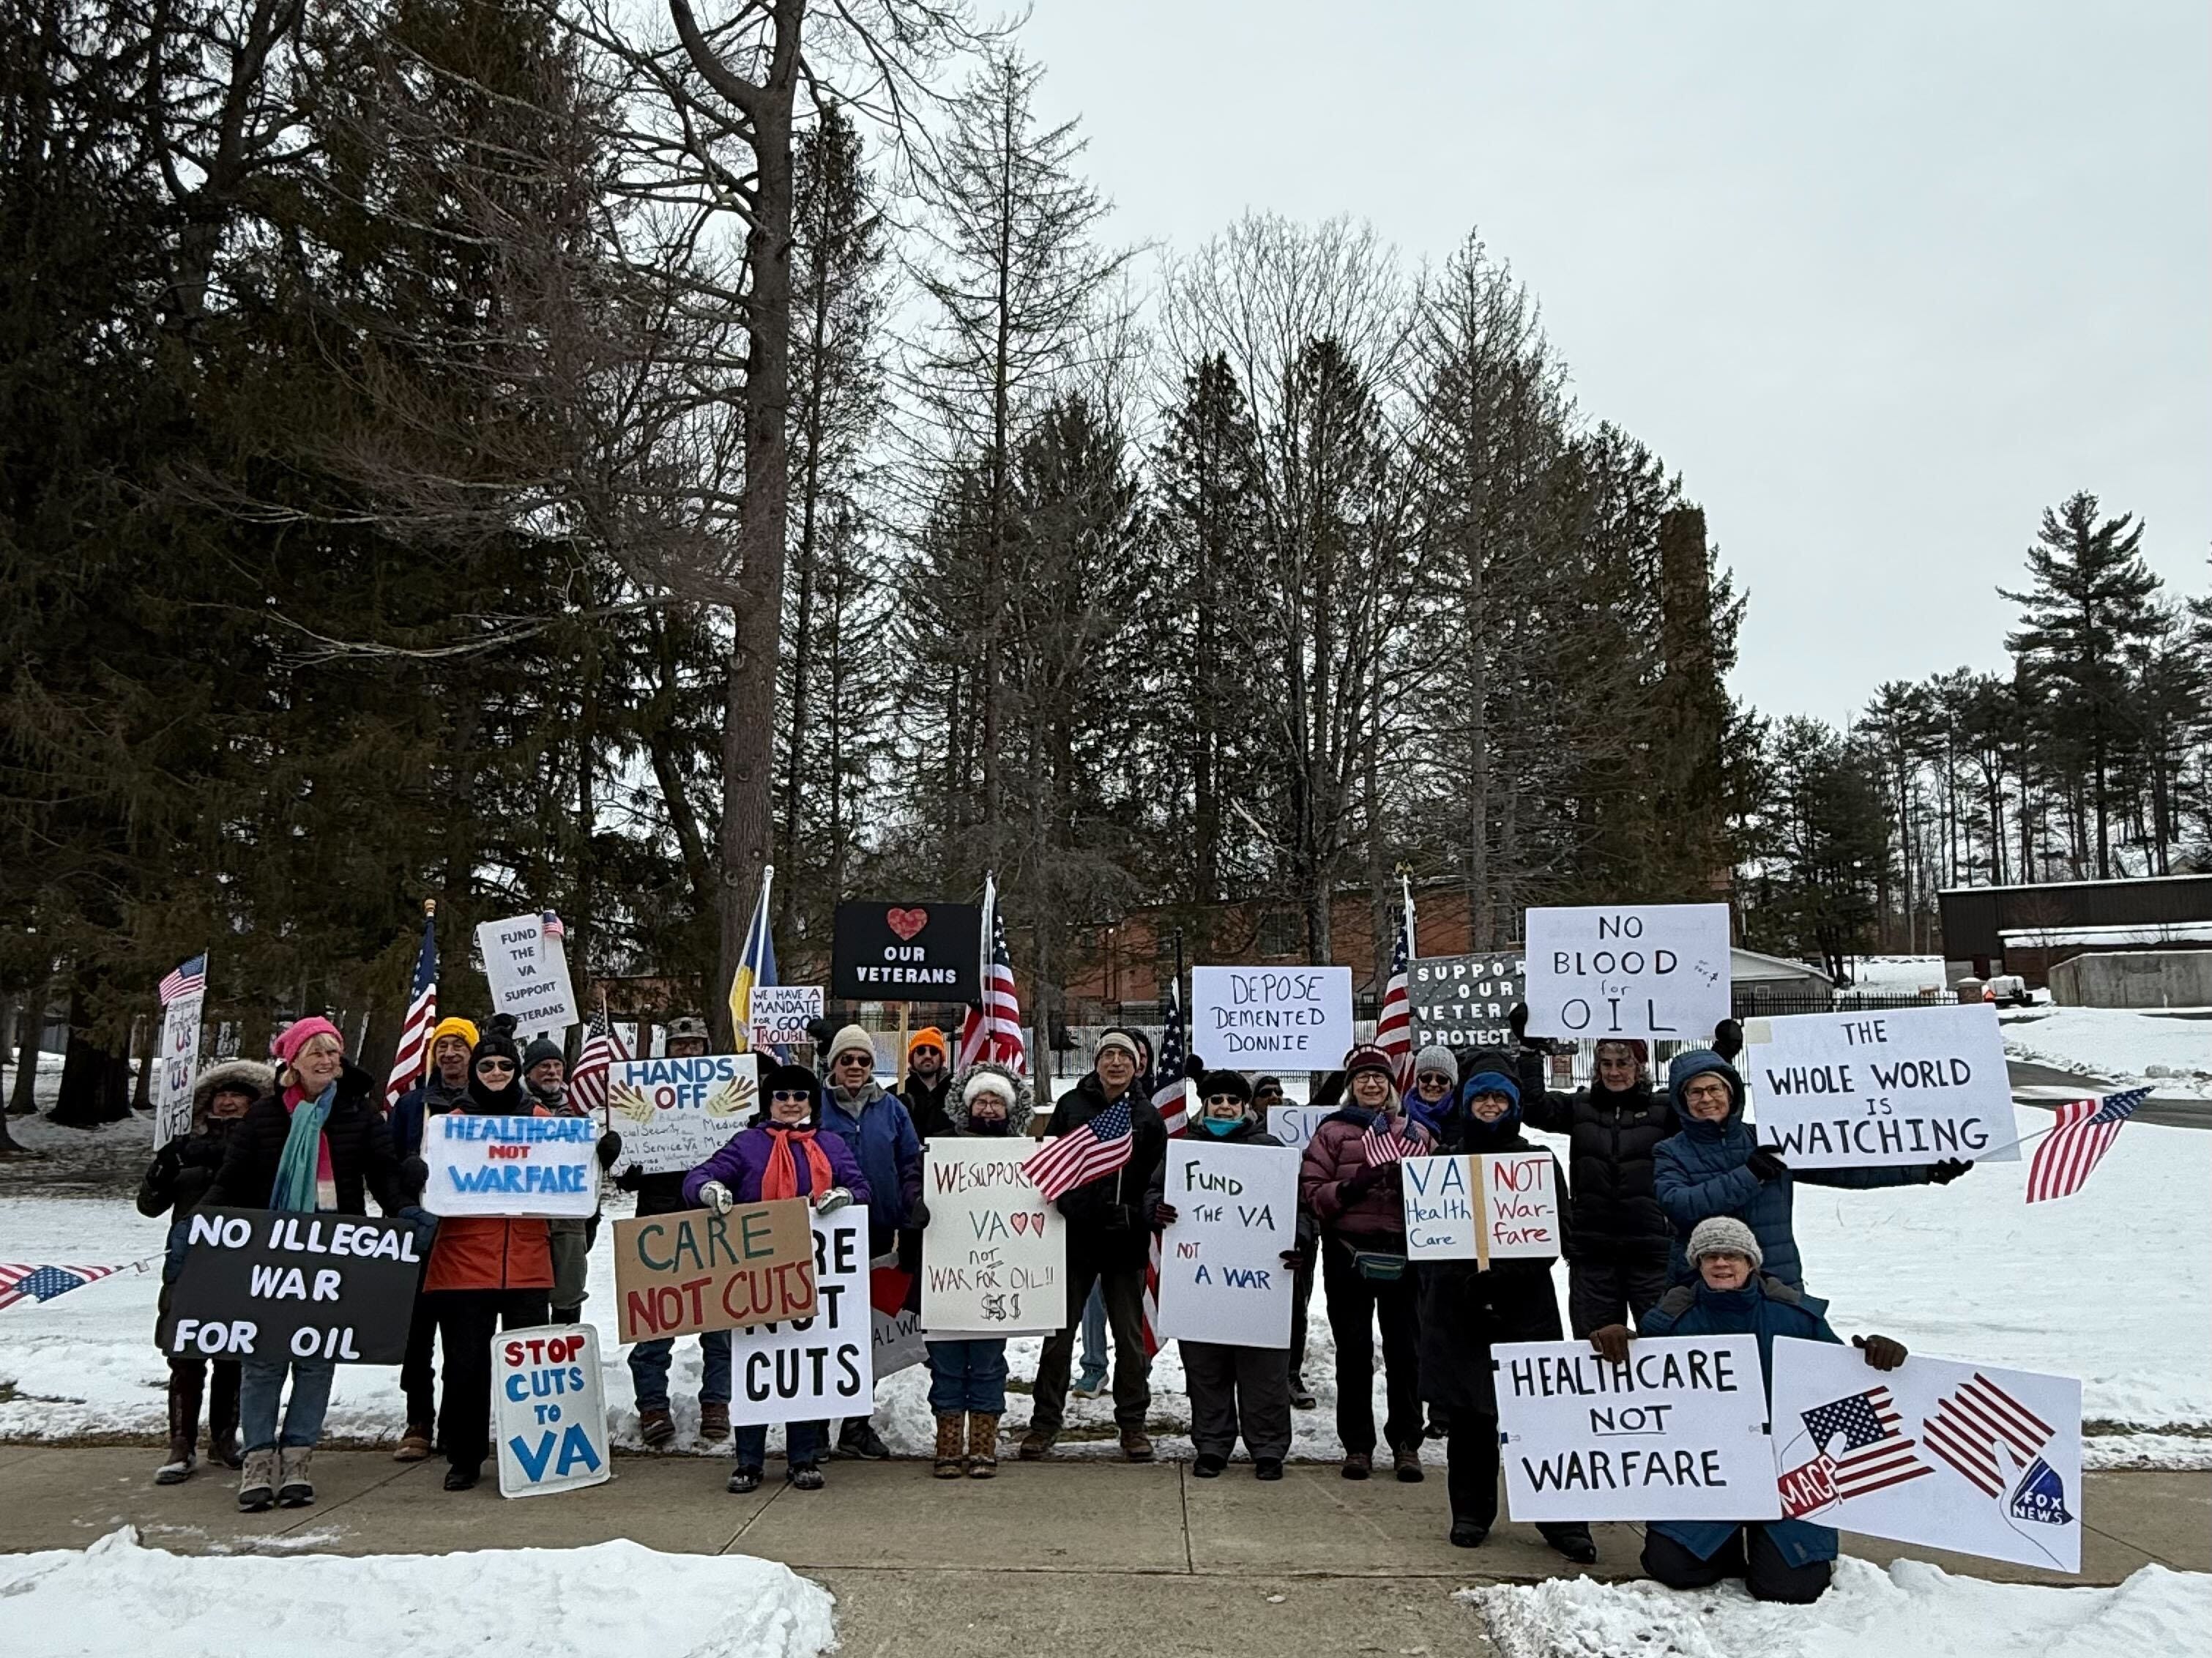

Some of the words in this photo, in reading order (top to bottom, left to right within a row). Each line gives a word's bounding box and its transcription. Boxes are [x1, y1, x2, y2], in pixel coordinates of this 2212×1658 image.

[501, 929, 537, 945] FUND
[1599, 915, 1643, 940] NO
[510, 946, 535, 961] THE
[884, 946, 926, 962] OUR
[1554, 949, 1678, 975] BLOOD
[517, 964, 537, 977] VA
[856, 966, 957, 984] VETERANS
[1417, 961, 1525, 982] SUPPOR
[504, 981, 557, 1002] SUPPORT
[753, 989, 768, 1000] WE
[776, 989, 803, 1000] HAVE
[808, 988, 820, 999] A
[1230, 973, 1325, 1005] DEPOSE
[1458, 982, 1513, 999] OUR
[1601, 978, 1633, 996] for
[515, 1003, 565, 1023] ETERANS
[752, 1000, 821, 1014] MANDATE
[1210, 1006, 1325, 1030] DEMENTED
[1561, 997, 1677, 1032] OIL
[176, 1025, 192, 1052] US
[1224, 1033, 1309, 1053] DONNIE
[1419, 1029, 1512, 1046] PROTECT
[1840, 1019, 1888, 1046] THE
[171, 1066, 188, 1091] US
[626, 1057, 735, 1087] HANDS
[1766, 1064, 1855, 1096] WHOLE
[1870, 1058, 1971, 1090] WORLD
[655, 1083, 708, 1110] OFF
[1866, 1098, 1893, 1116] IS
[444, 1116, 597, 1145] HEALTHCARE
[1769, 1118, 1989, 1156] WATCHING
[488, 1145, 532, 1159] NOT
[642, 1142, 682, 1154] Service
[447, 1164, 588, 1193] WARFARE
[1185, 1160, 1243, 1196] FUND
[1406, 1157, 1465, 1197] VA
[1494, 1159, 1554, 1192] NOT
[1192, 1204, 1224, 1222] THE
[1237, 1204, 1276, 1232] VA
[1405, 1197, 1472, 1225] Health
[187, 1213, 252, 1249] NO
[268, 1219, 421, 1263] ILLEGAL
[969, 1210, 1010, 1241] VA
[1410, 1227, 1457, 1248] Care
[637, 1211, 775, 1274] CARE
[1177, 1242, 1201, 1260] NOT
[250, 1264, 342, 1301] WAR
[928, 1265, 973, 1293] WAR
[976, 1270, 1002, 1289] FOR
[1194, 1264, 1213, 1285] A
[1223, 1267, 1271, 1290] WAR
[628, 1276, 712, 1337] NOT
[722, 1260, 816, 1320] CUTS
[173, 1319, 258, 1353] FOR
[291, 1326, 361, 1360] OIL
[504, 1335, 586, 1367] STOP
[505, 1367, 585, 1403] CUTS
[745, 1342, 861, 1402] CUTS
[1511, 1349, 1738, 1397] HEALTHCARE
[534, 1404, 562, 1425] TO
[1590, 1404, 1673, 1433] NOT
[508, 1422, 602, 1483] VA
[1521, 1449, 1728, 1494] WARFARE
[2013, 1504, 2063, 1525] NEWS
[2024, 1491, 2062, 1511] FOX
